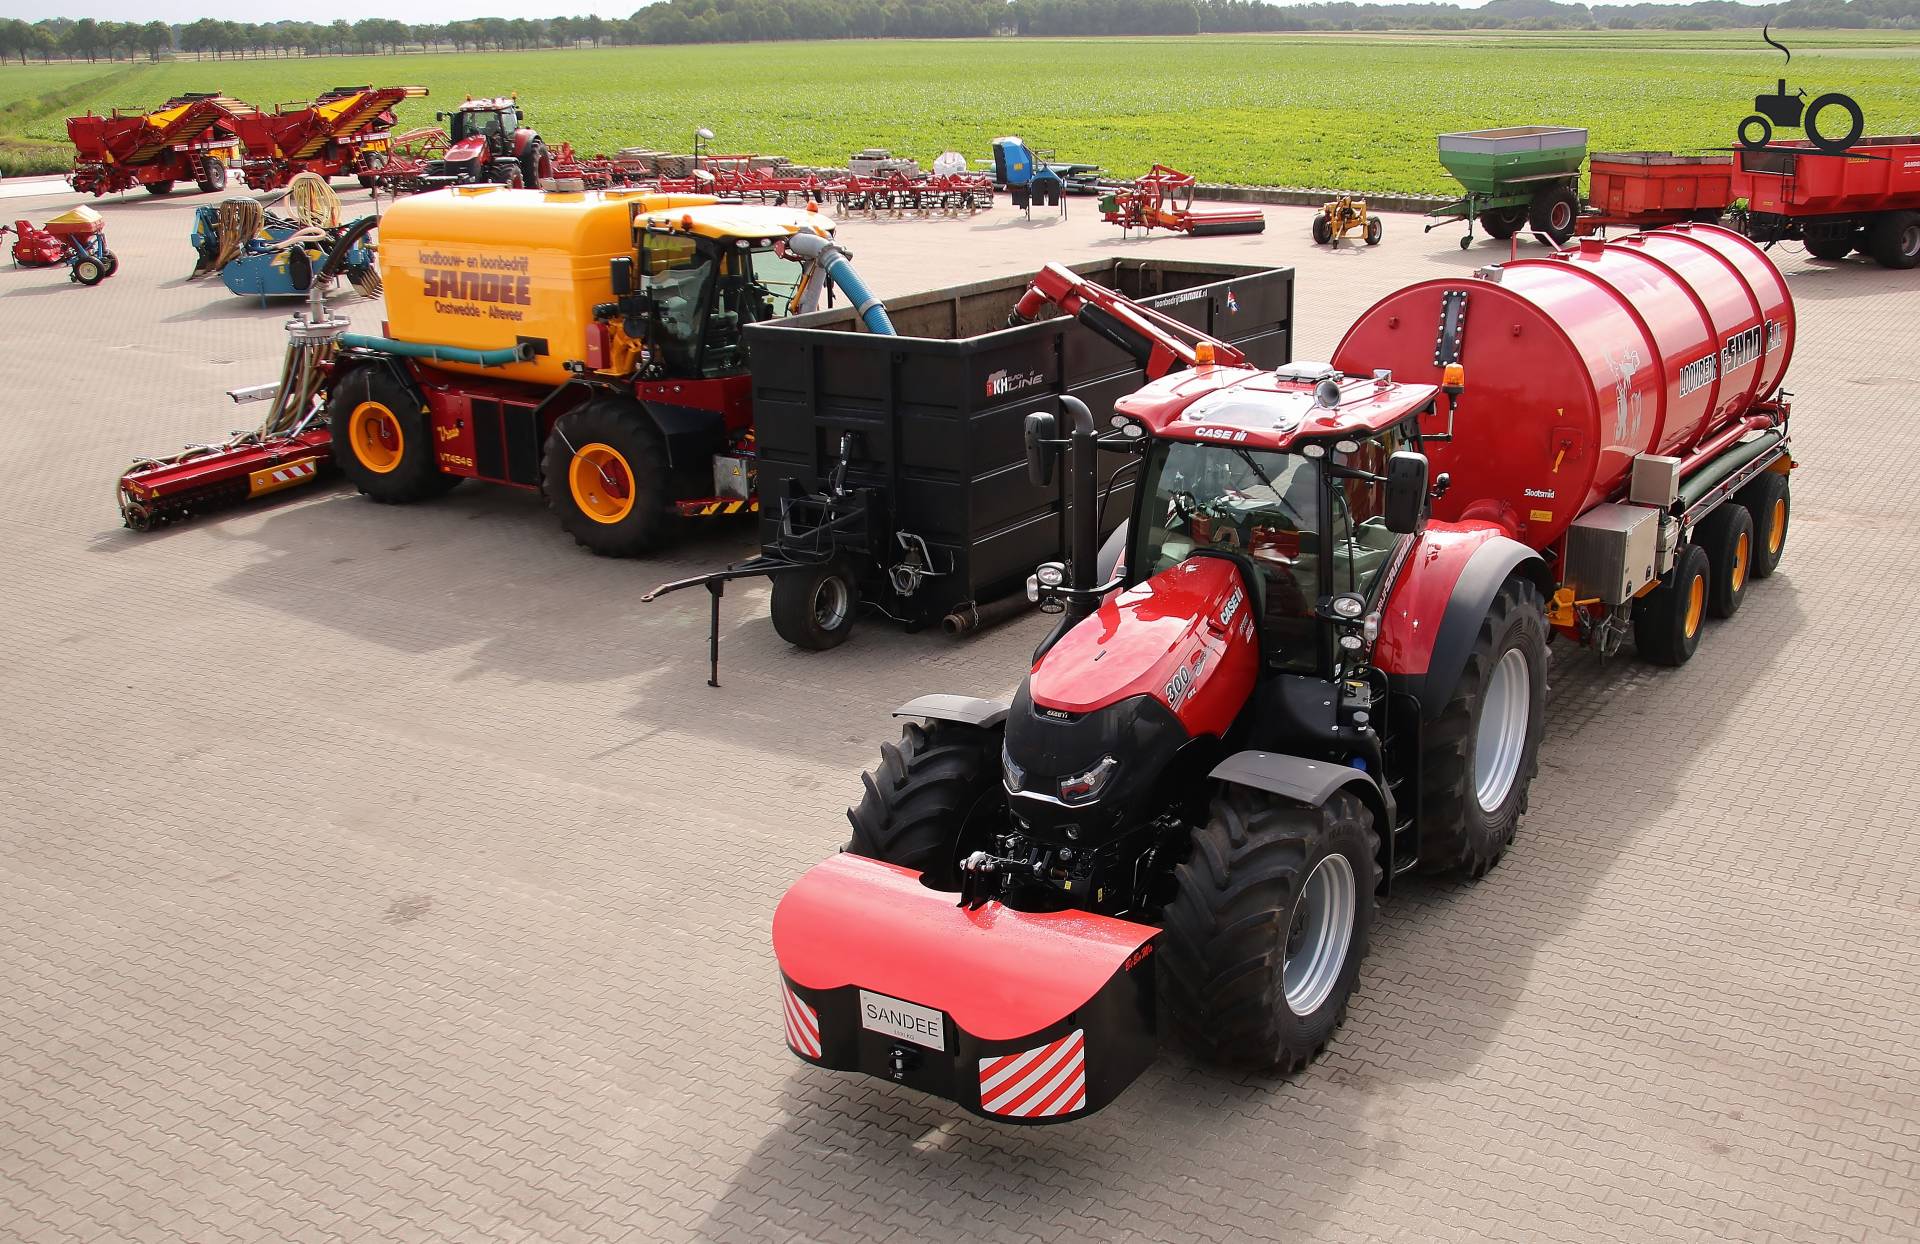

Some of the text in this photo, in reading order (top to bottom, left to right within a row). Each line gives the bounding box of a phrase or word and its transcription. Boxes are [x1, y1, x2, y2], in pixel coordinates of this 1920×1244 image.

[419, 249, 529, 275] landbouw- en loonbedrijf
[424, 268, 531, 305] SANDEE
[435, 300, 481, 317] Onstwedde
[1195, 427, 1234, 440] CASE
[1220, 594, 1240, 625] CASE
[1165, 666, 1189, 704] 300
[866, 1003, 939, 1038] SANDEE
